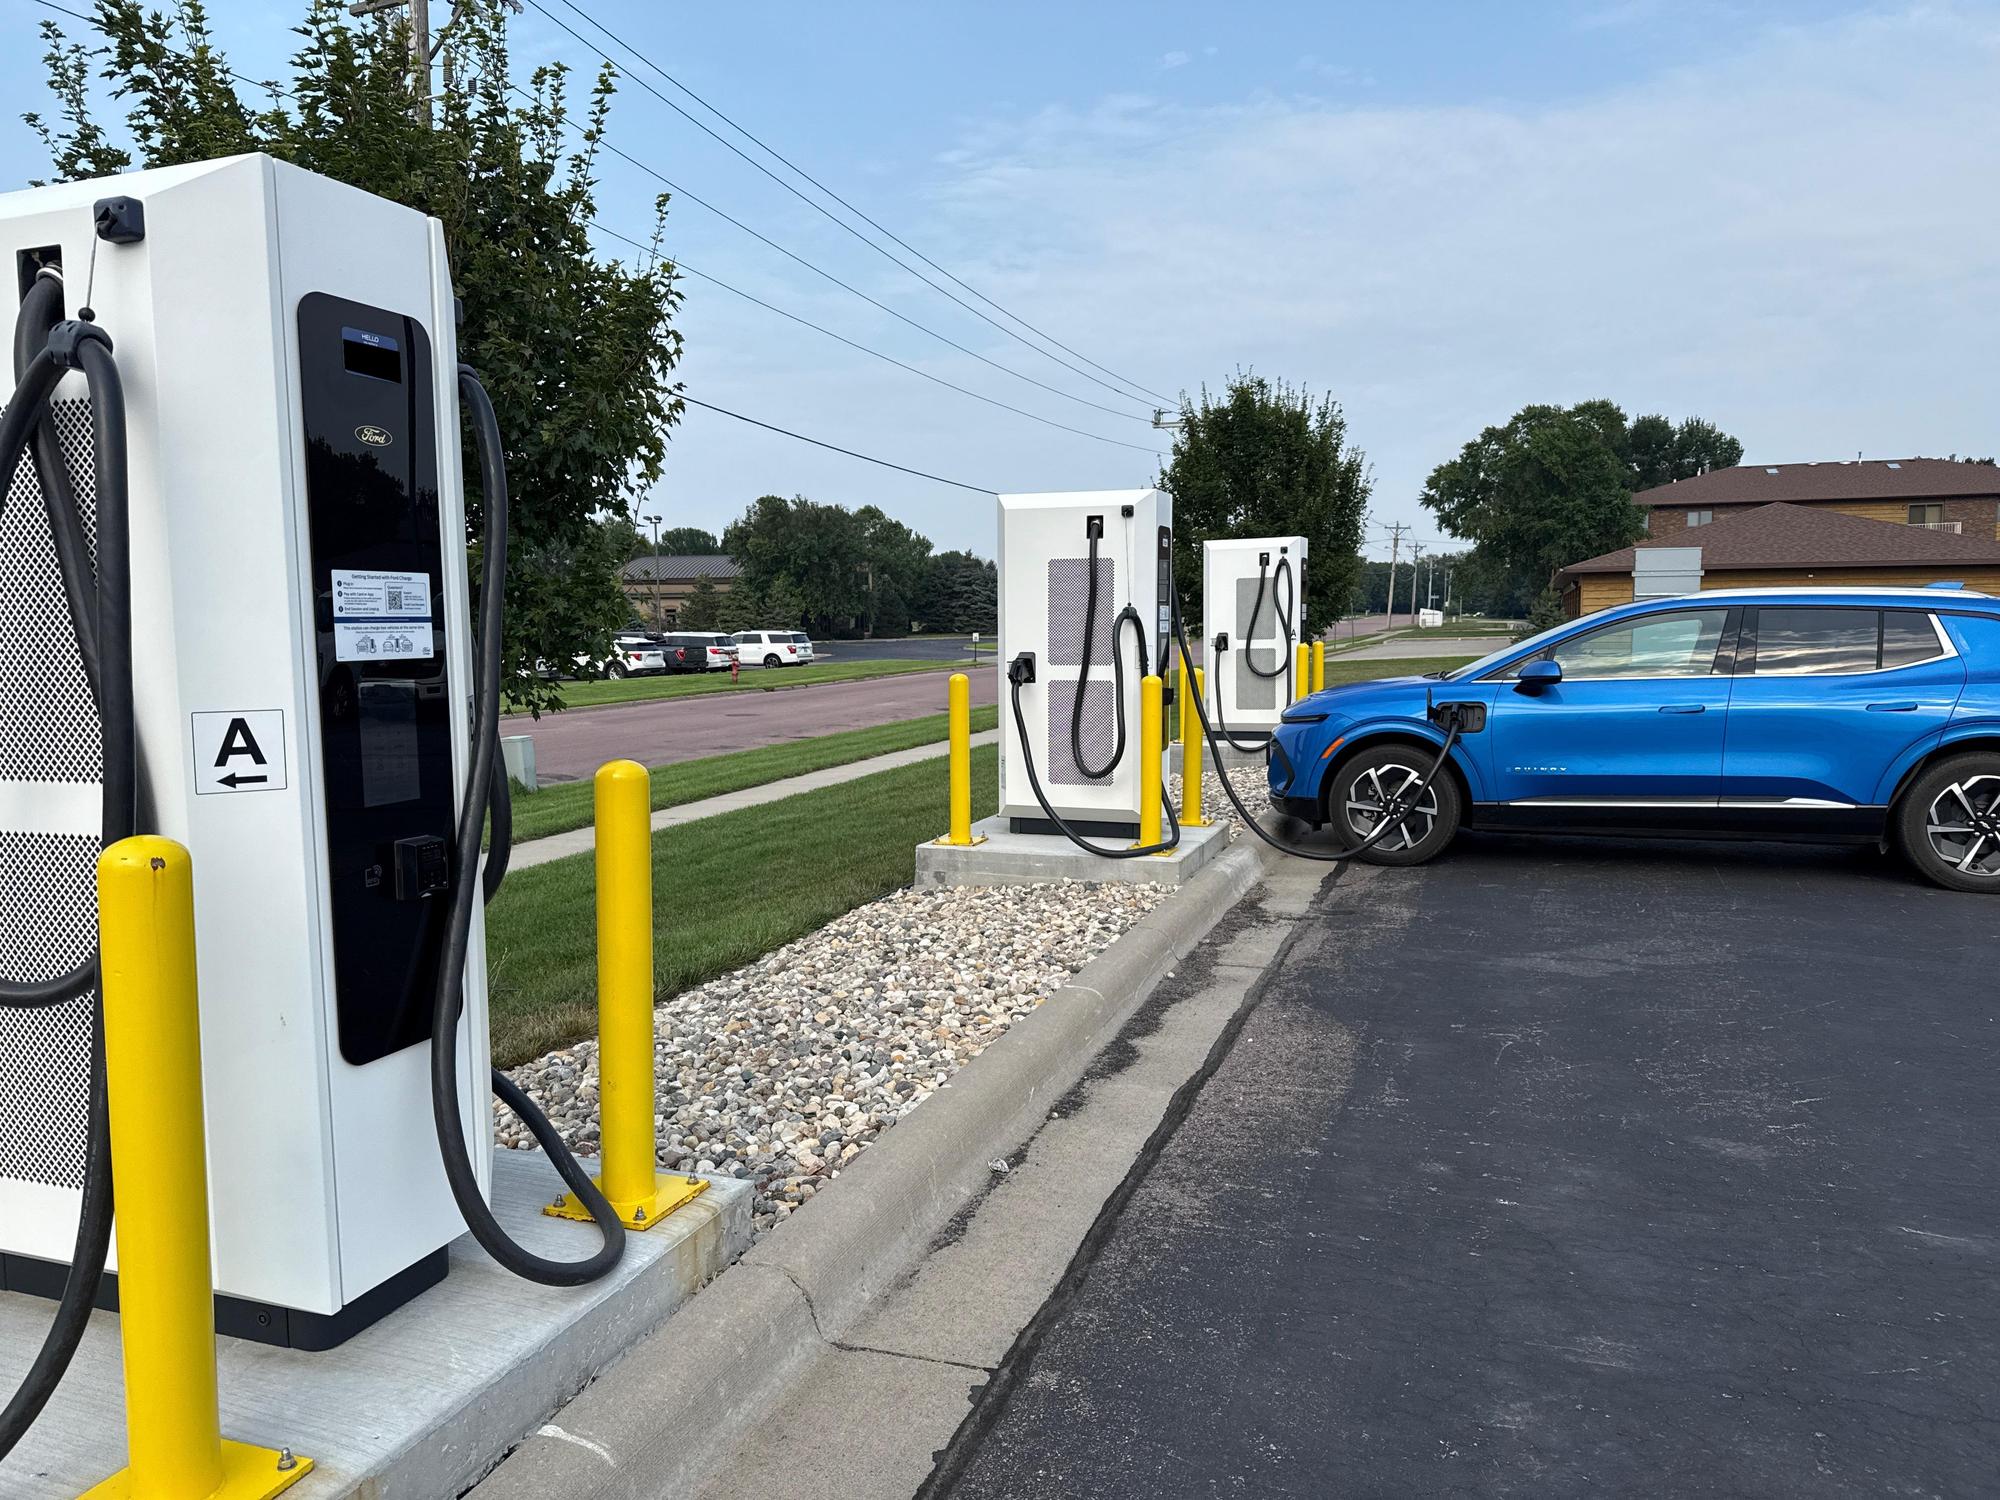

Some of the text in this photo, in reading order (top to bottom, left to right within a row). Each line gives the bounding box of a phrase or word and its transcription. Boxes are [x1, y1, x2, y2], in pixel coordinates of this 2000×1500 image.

[362, 334, 380, 343] HELLO
[361, 428, 386, 444] Ford
[214, 718, 268, 767] A
